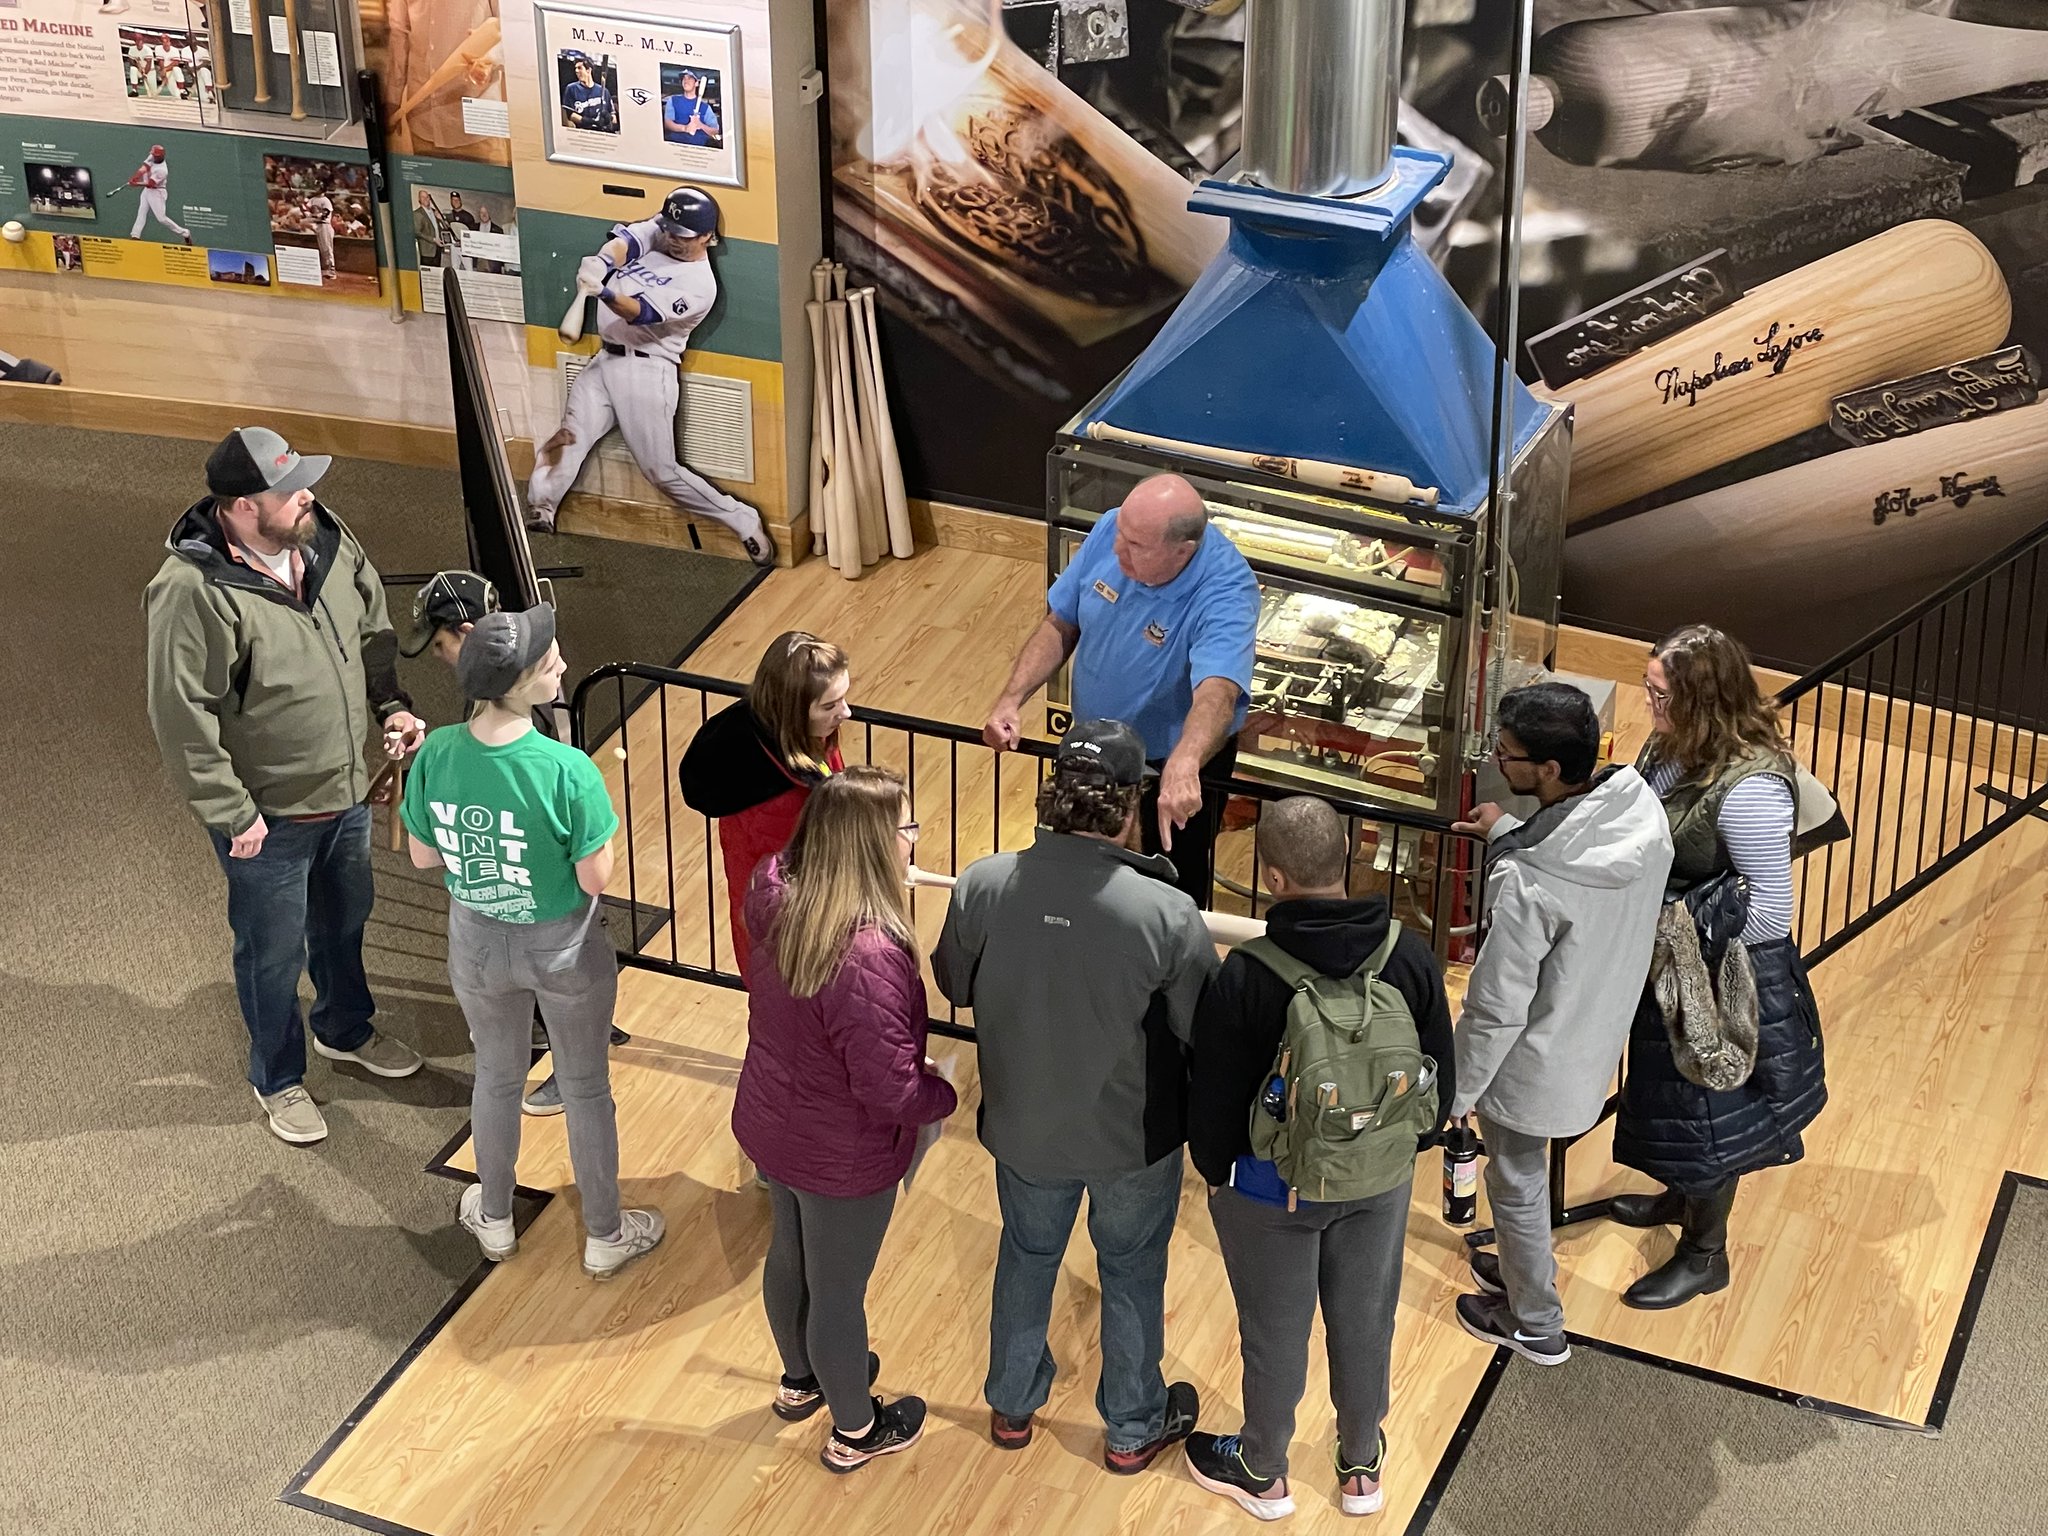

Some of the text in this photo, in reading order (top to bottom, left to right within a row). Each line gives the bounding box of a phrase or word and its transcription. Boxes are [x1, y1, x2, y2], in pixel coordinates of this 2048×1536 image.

[0, 17, 94, 38] ED MACHINE
[669, 202, 682, 221] KC
